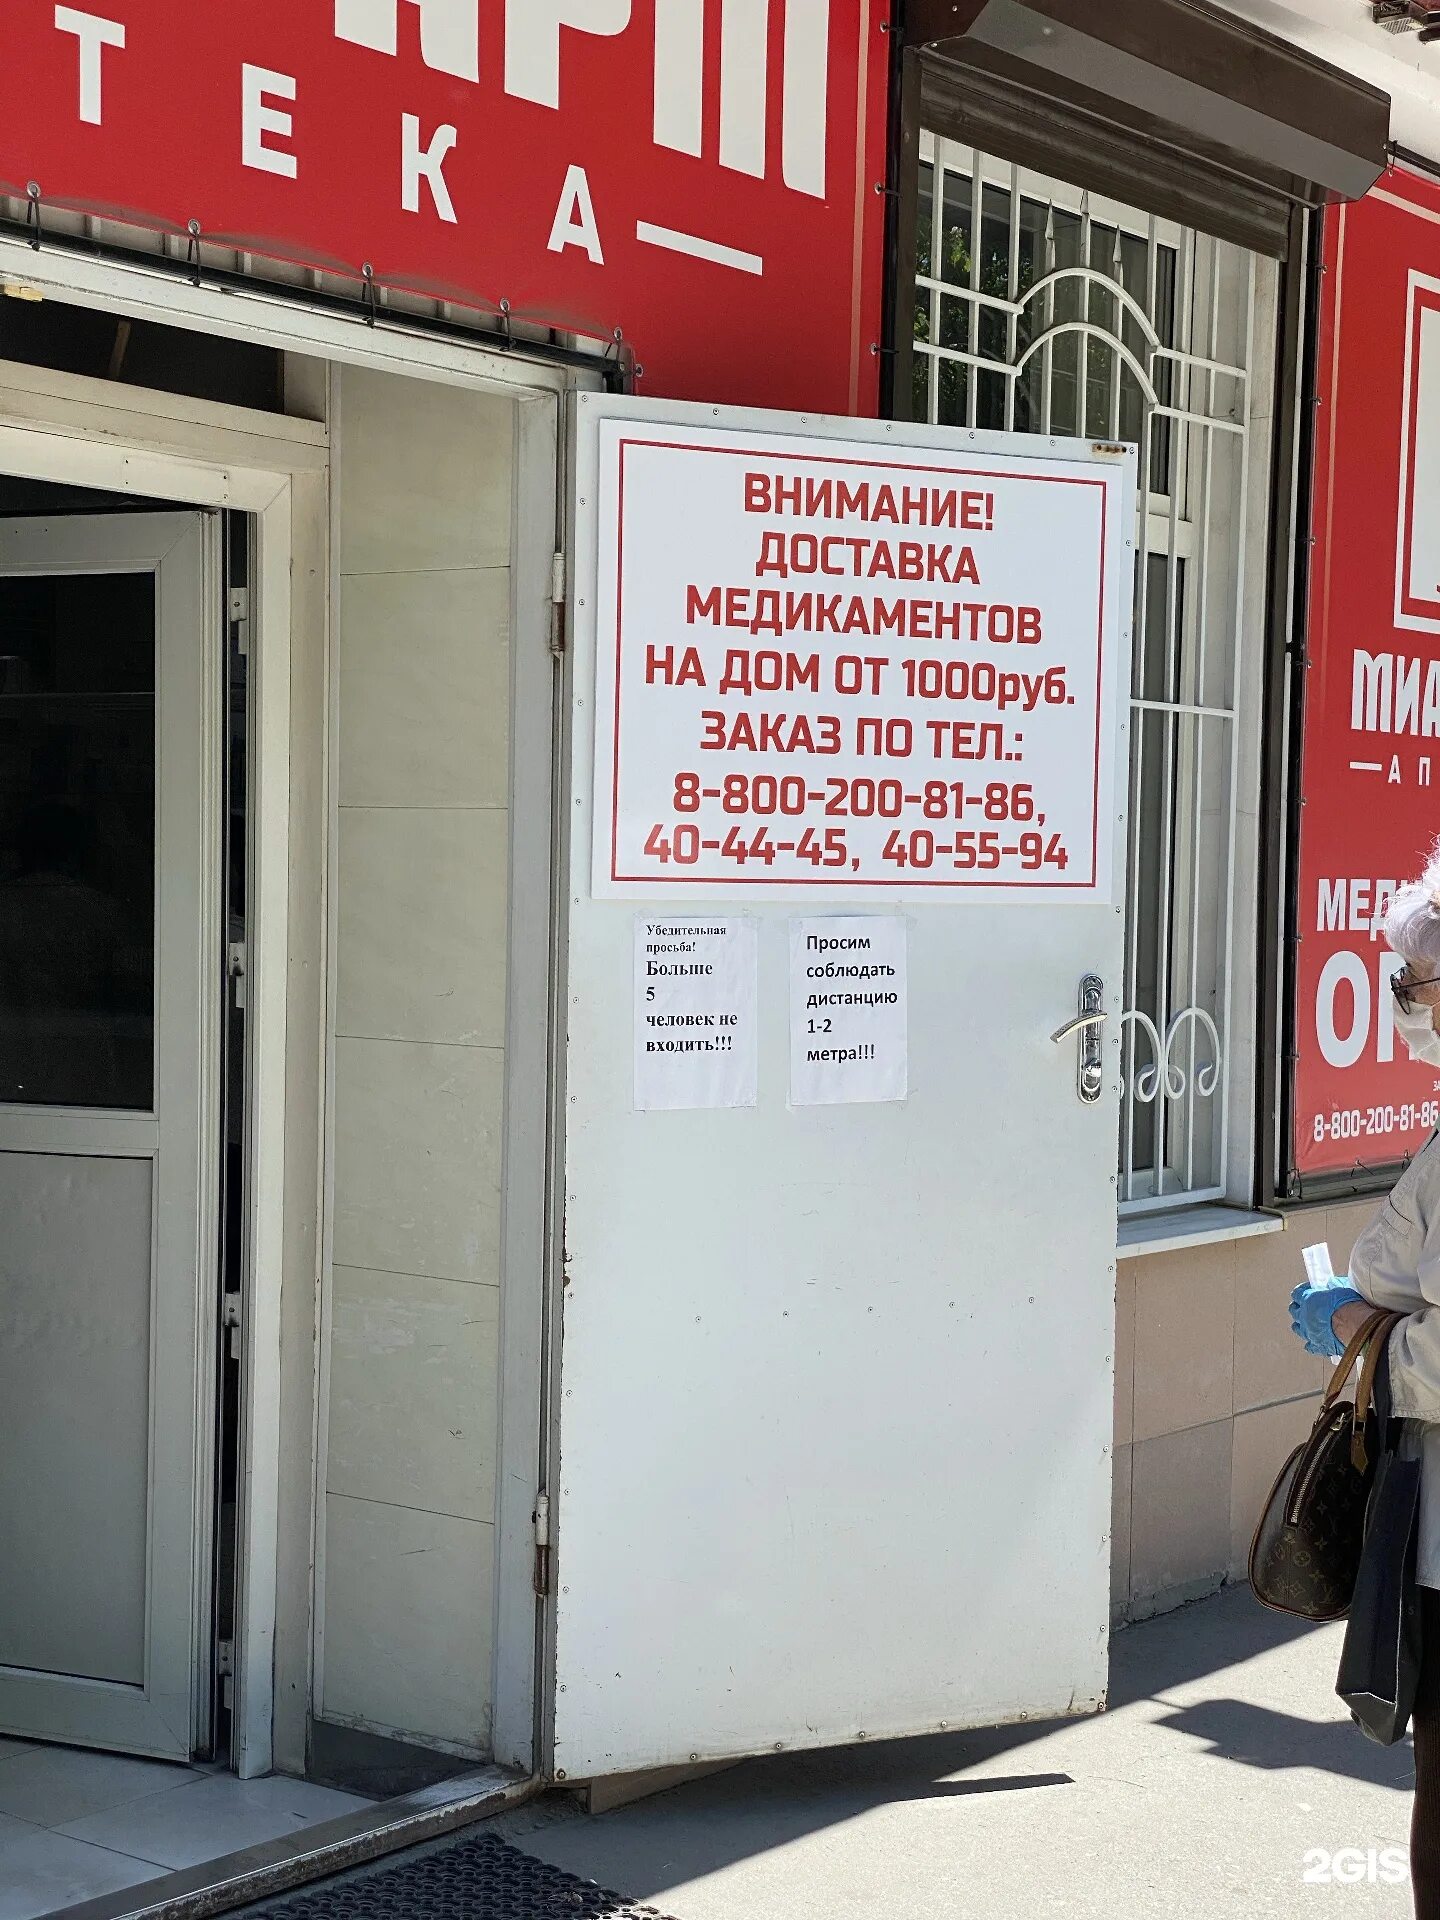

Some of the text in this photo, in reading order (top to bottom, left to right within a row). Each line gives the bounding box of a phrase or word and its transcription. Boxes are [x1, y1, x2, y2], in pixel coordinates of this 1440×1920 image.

[744, 472, 994, 530] ВНИМАНИЕ!
[755, 531, 981, 585] ДОСТАВКА
[685, 584, 1042, 644] МЕДИКАМЕНТОВ
[645, 644, 1075, 711] НА ДОМ ОТ 1000руб.
[700, 710, 1023, 761] ЗАКАЗ ПО ТЕЛ.:
[673, 772, 1046, 827] 8-800-200-81-86,
[644, 824, 1069, 871] 40-44-45, 40-55-94
[646, 925, 727, 936] Убедительная
[646, 942, 696, 953] просьба!
[807, 935, 871, 953] Просим
[646, 960, 713, 976] Больше
[806, 962, 896, 979] соблюдать
[646, 986, 655, 1001] 5
[806, 991, 898, 1009] дистанцию
[646, 1013, 738, 1027] человек не
[807, 1018, 833, 1034] 1-2
[646, 1035, 732, 1053] входить!!!
[807, 1044, 875, 1063] метра!!!
[1313, 1100, 1439, 1142] 8-800-200-81-86
